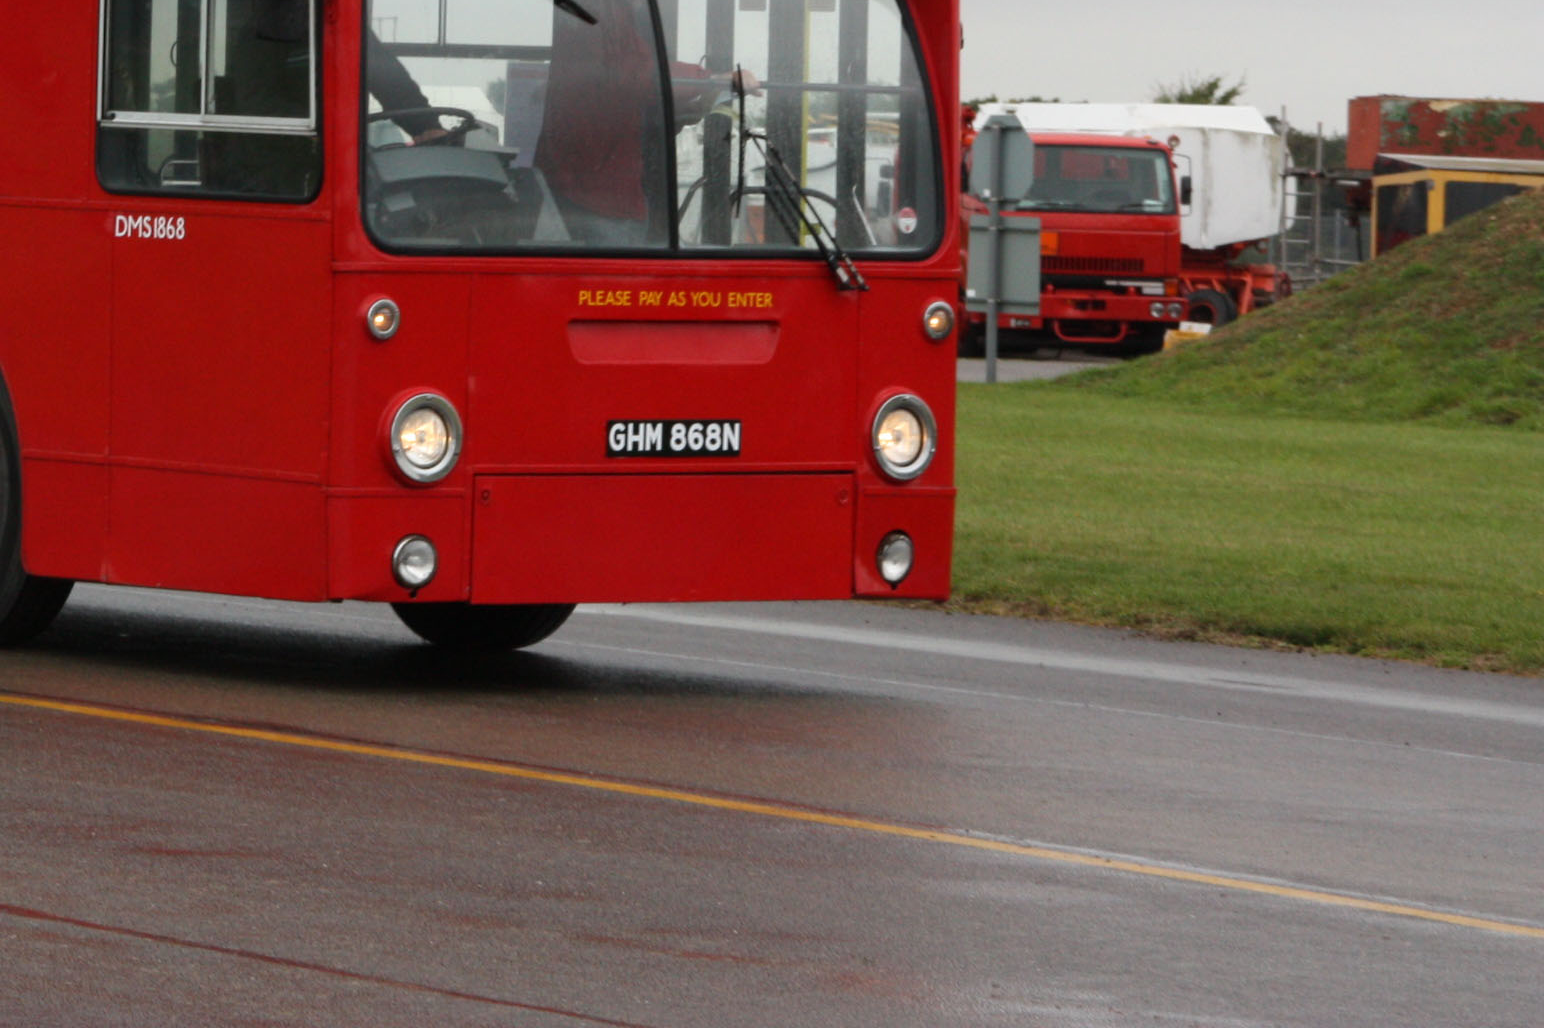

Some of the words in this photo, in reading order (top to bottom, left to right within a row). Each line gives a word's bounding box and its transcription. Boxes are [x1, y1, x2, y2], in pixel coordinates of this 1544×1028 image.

[114, 214, 186, 240] DMS1868
[578, 290, 632, 307] PLEASE
[638, 290, 664, 307] PAY
[667, 291, 687, 307] AS
[690, 291, 722, 308] YOU
[727, 292, 774, 308] ENTER
[608, 422, 664, 452] GHM
[669, 422, 741, 452] 868N
